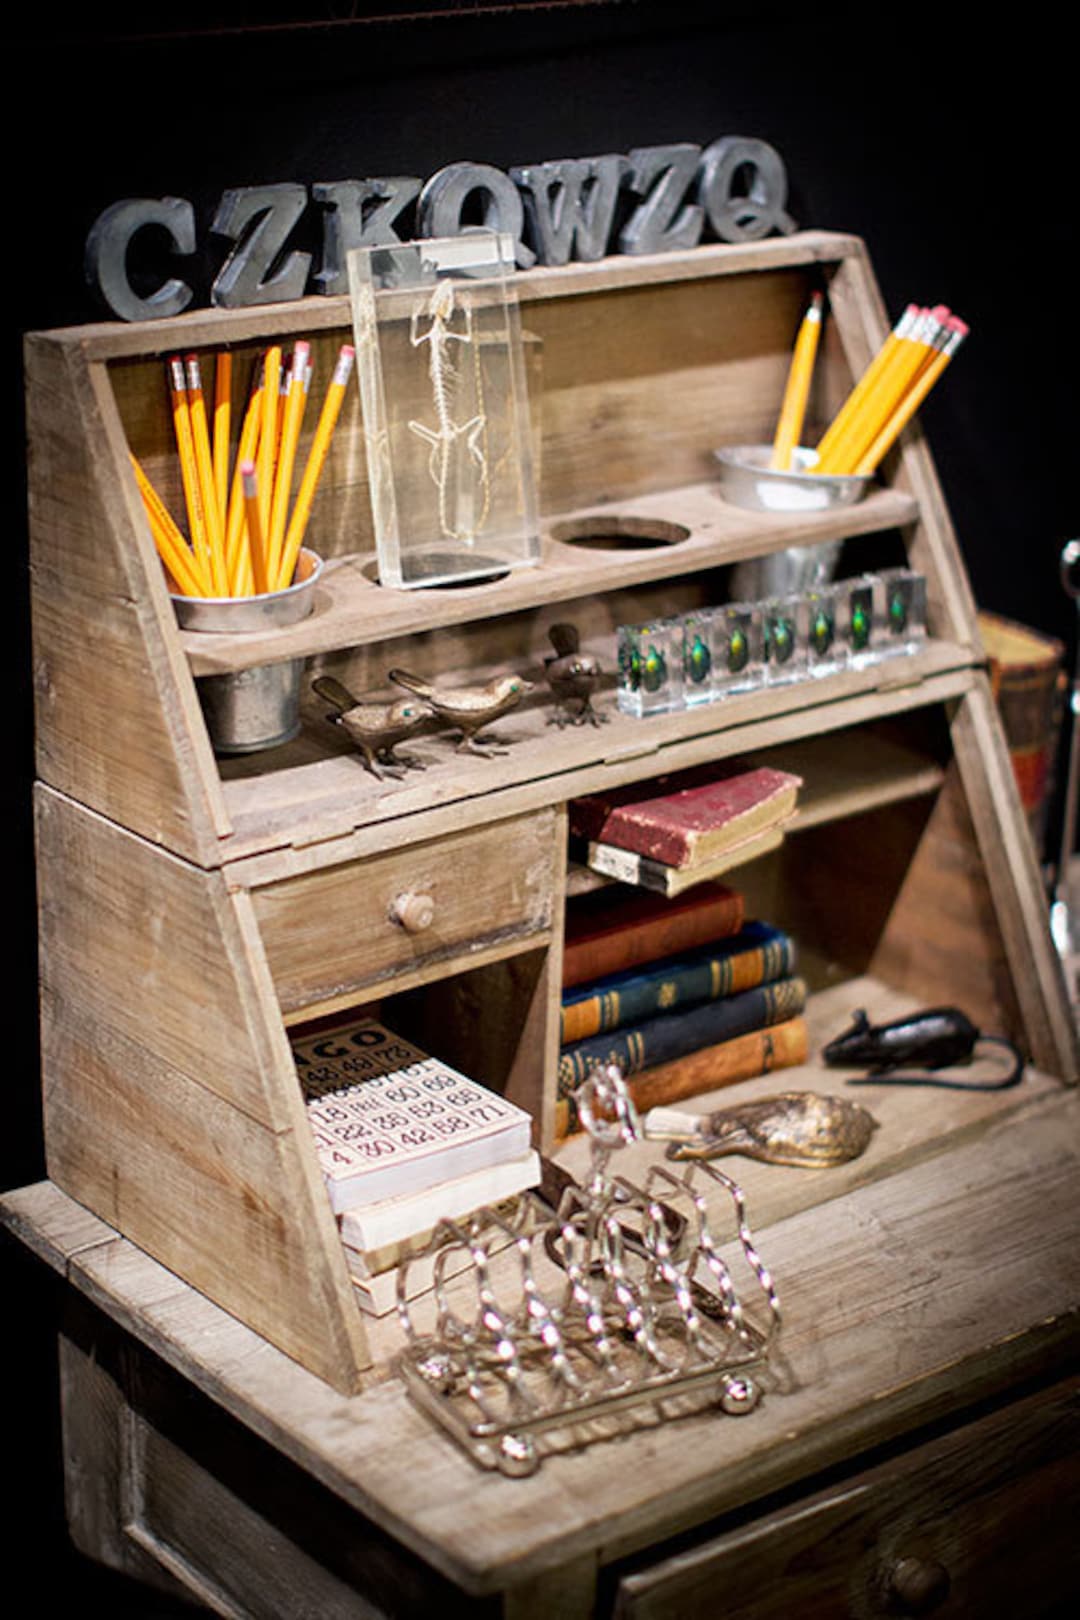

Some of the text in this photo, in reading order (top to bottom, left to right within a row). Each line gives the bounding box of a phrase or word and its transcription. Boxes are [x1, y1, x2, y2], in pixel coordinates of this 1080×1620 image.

[312, 1107, 349, 1123] 18
[333, 1151, 352, 1164] 4
[357, 1140, 395, 1157] 30
[401, 1129, 435, 1145] 42
[469, 1104, 507, 1122] 71
[334, 1123, 372, 1140] 22
